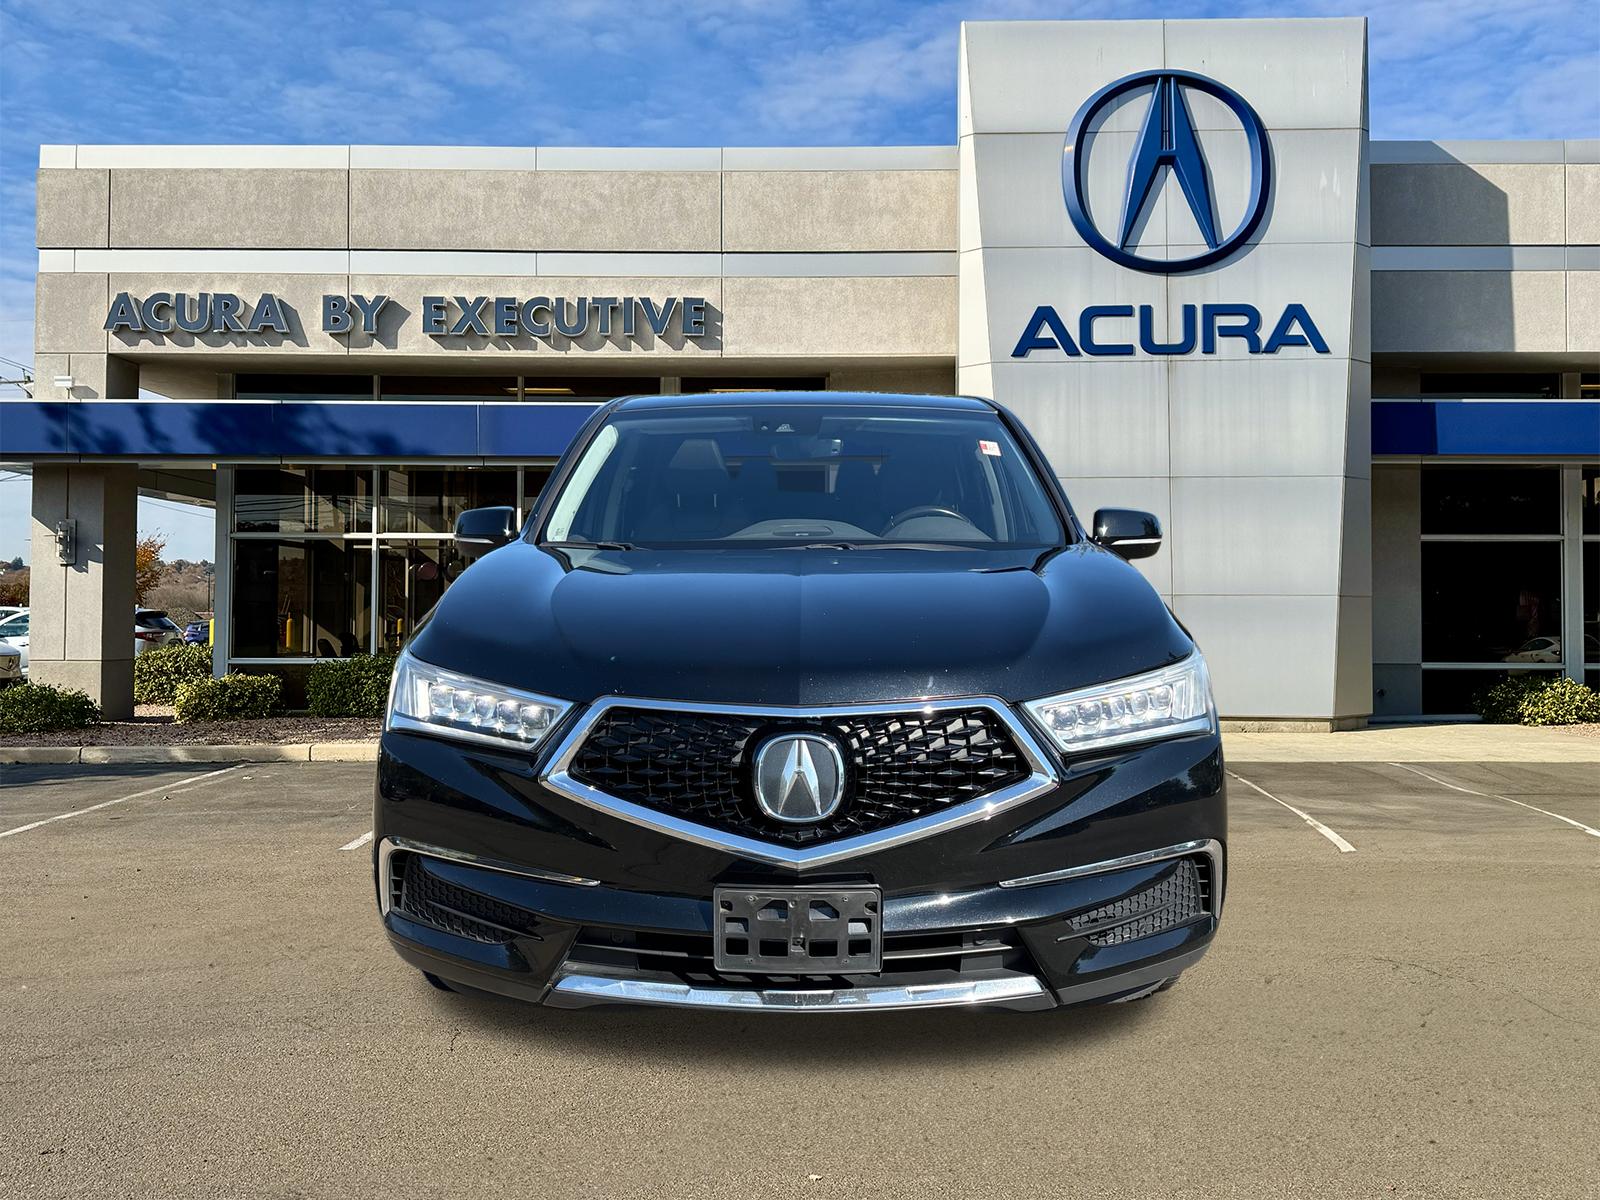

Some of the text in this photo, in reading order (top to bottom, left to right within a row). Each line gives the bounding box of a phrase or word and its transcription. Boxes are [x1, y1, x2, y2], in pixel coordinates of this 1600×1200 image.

[103, 292, 706, 337] ACURA BY EXECUTIVE
[1010, 303, 1332, 357] ACURA
